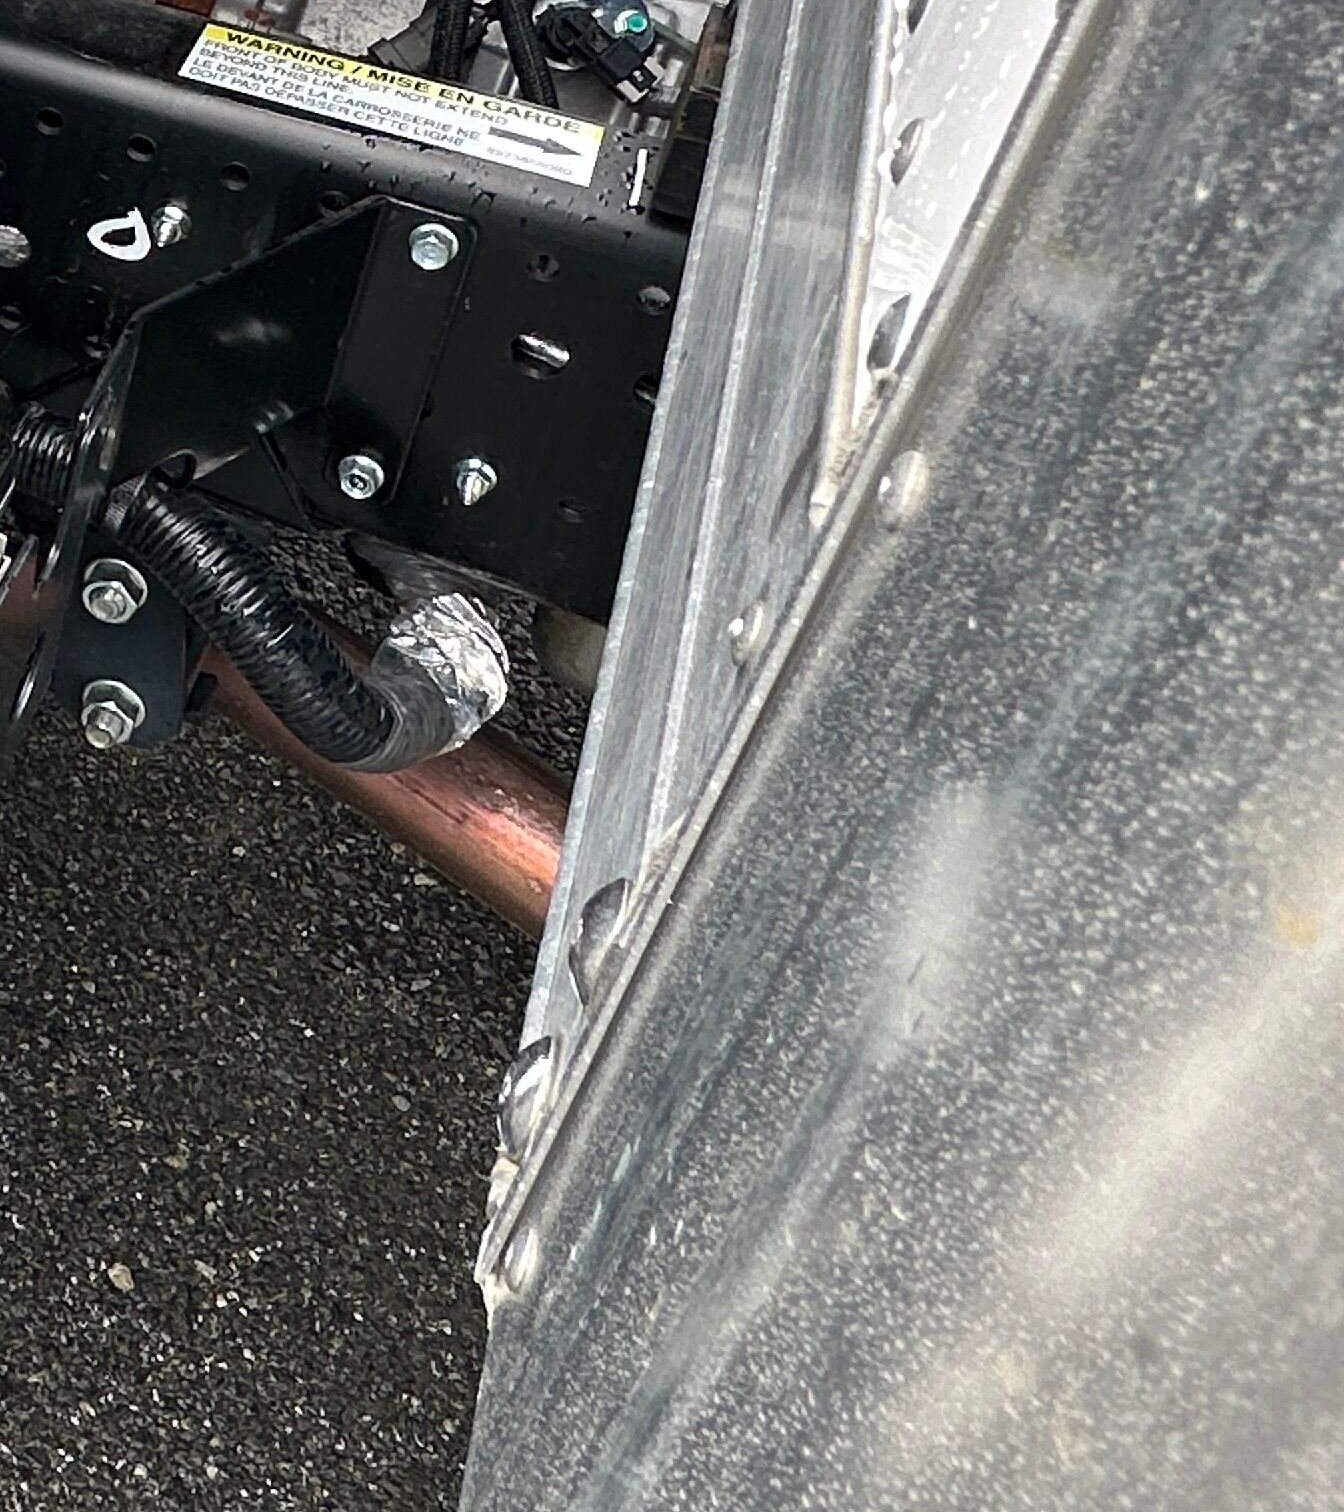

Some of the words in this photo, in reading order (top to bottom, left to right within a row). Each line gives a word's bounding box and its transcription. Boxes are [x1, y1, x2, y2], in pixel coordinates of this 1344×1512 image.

[187, 65, 228, 82] DOIT
[229, 76, 261, 91] PAS
[352, 109, 410, 132] CETTE
[412, 126, 464, 147] LIGNE
[192, 56, 214, 68] LE
[215, 62, 279, 86] DEVANT
[281, 80, 304, 93] DE
[306, 87, 329, 100] LA
[198, 47, 268, 72] BEYOND
[271, 66, 309, 83] THIS
[203, 38, 261, 60] FRONT
[262, 54, 287, 67] OF
[291, 62, 338, 80] BODY
[341, 75, 391, 94] MUST
[393, 88, 430, 105] NOT
[433, 99, 508, 126] EXTEND
[223, 31, 346, 71] WARNING
[366, 68, 431, 94] MISE
[437, 87, 475, 105] EN
[481, 98, 580, 133] GARDE
